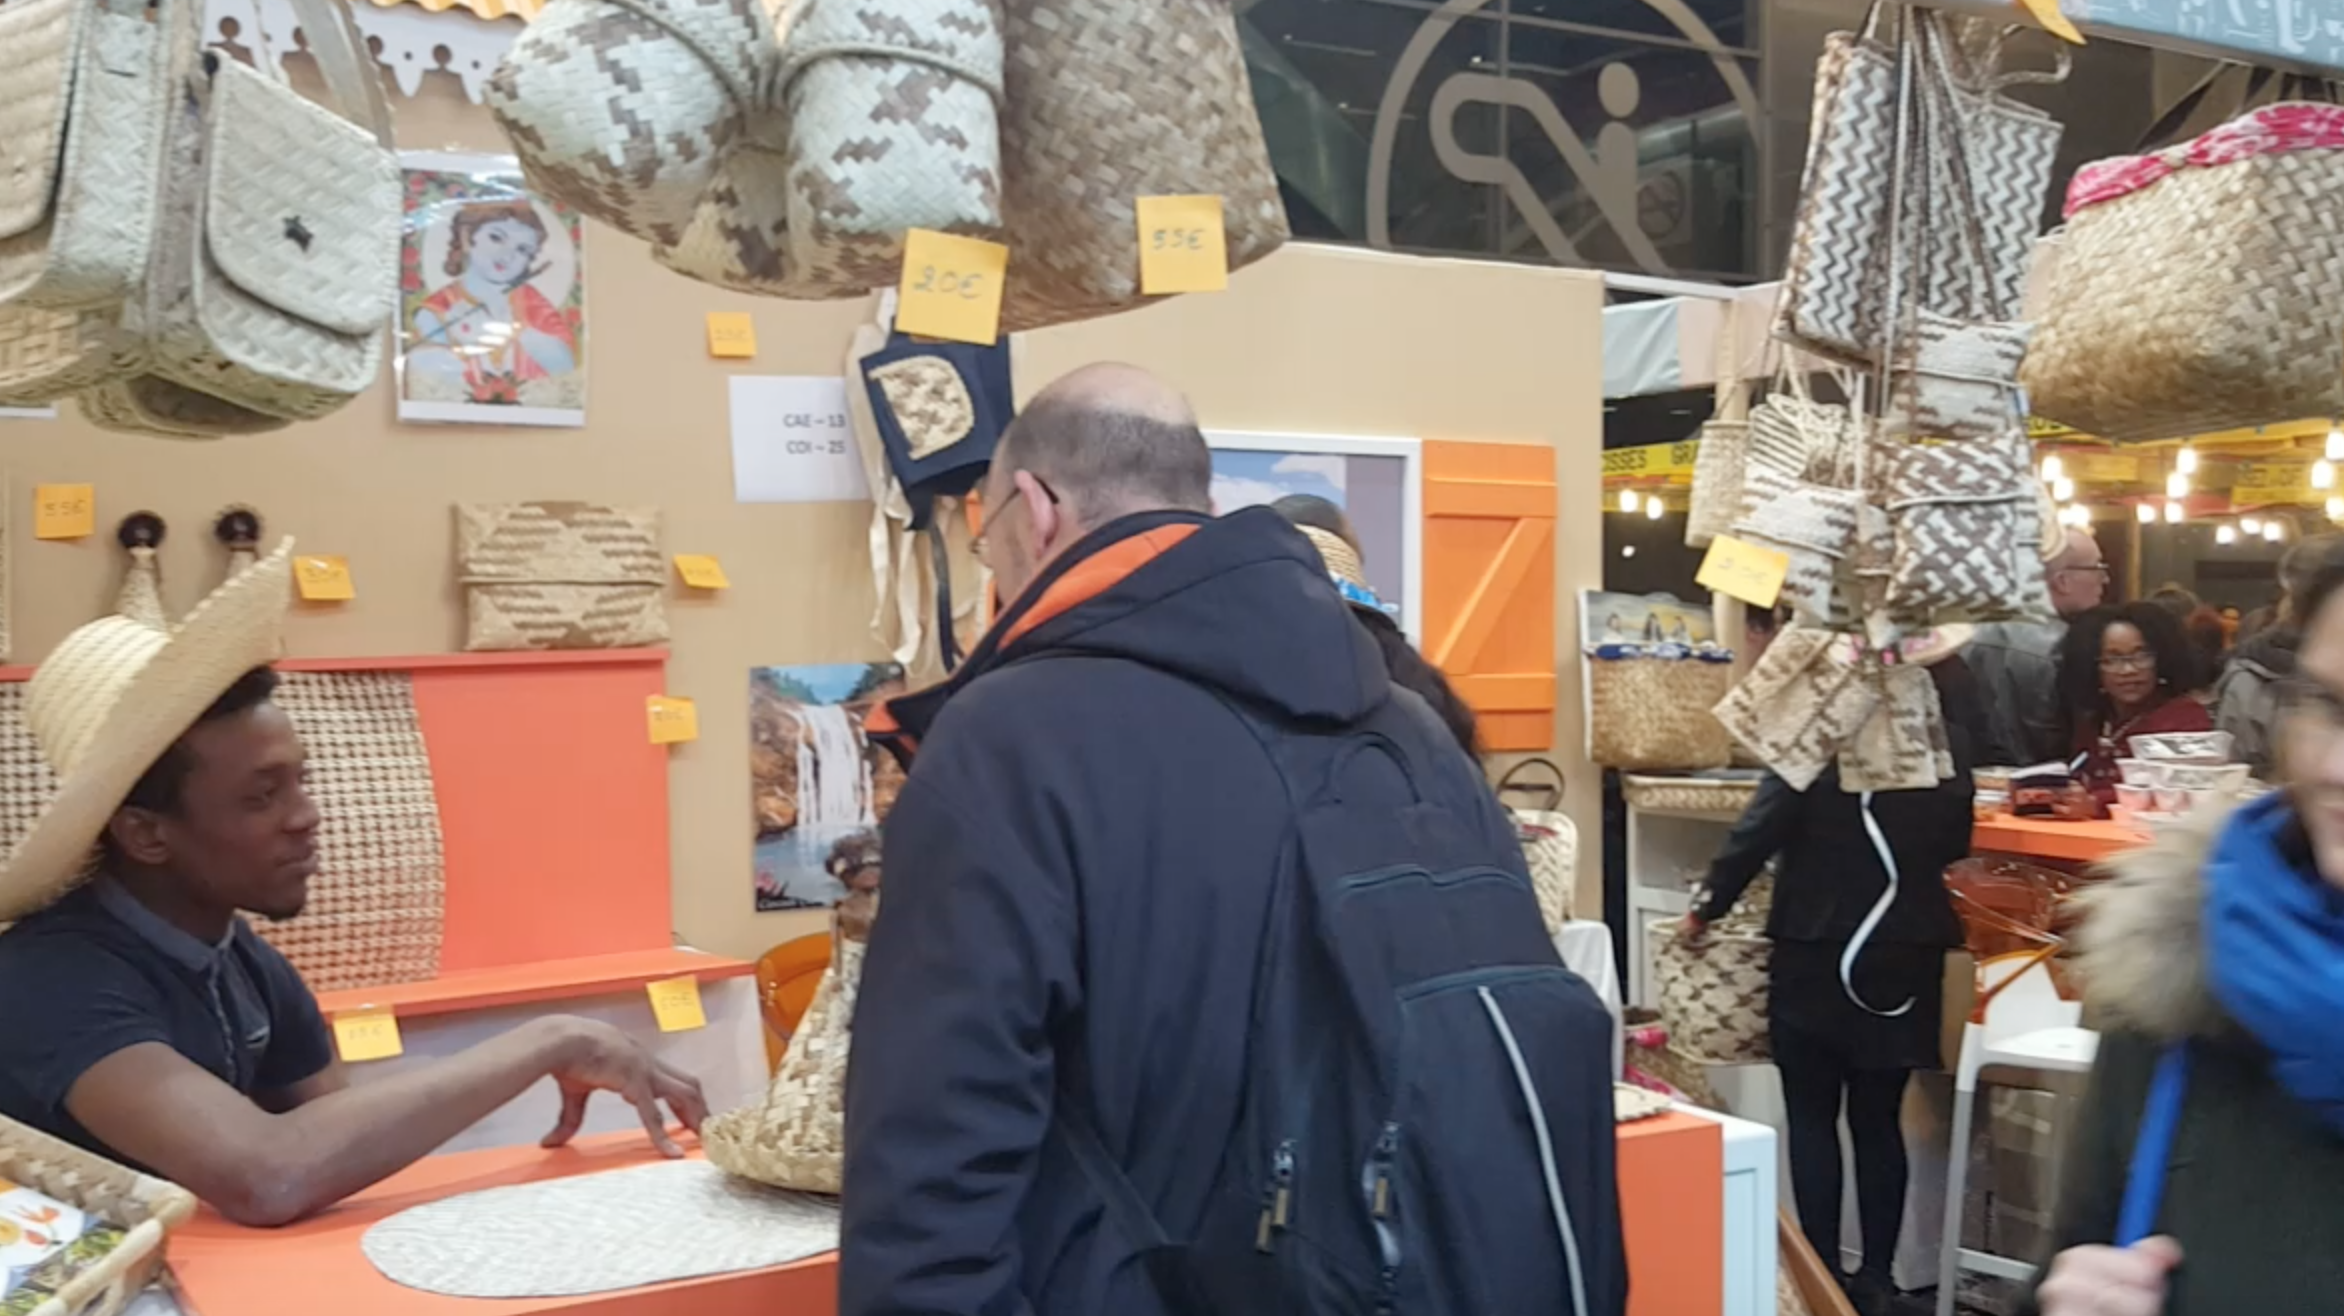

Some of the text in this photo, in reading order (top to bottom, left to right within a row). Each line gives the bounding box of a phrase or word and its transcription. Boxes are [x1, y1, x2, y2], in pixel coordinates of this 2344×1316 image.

[1153, 229, 1206, 250] 55€
[912, 264, 984, 299] 20€
[783, 413, 812, 428] CAE
[828, 439, 846, 454] 25
